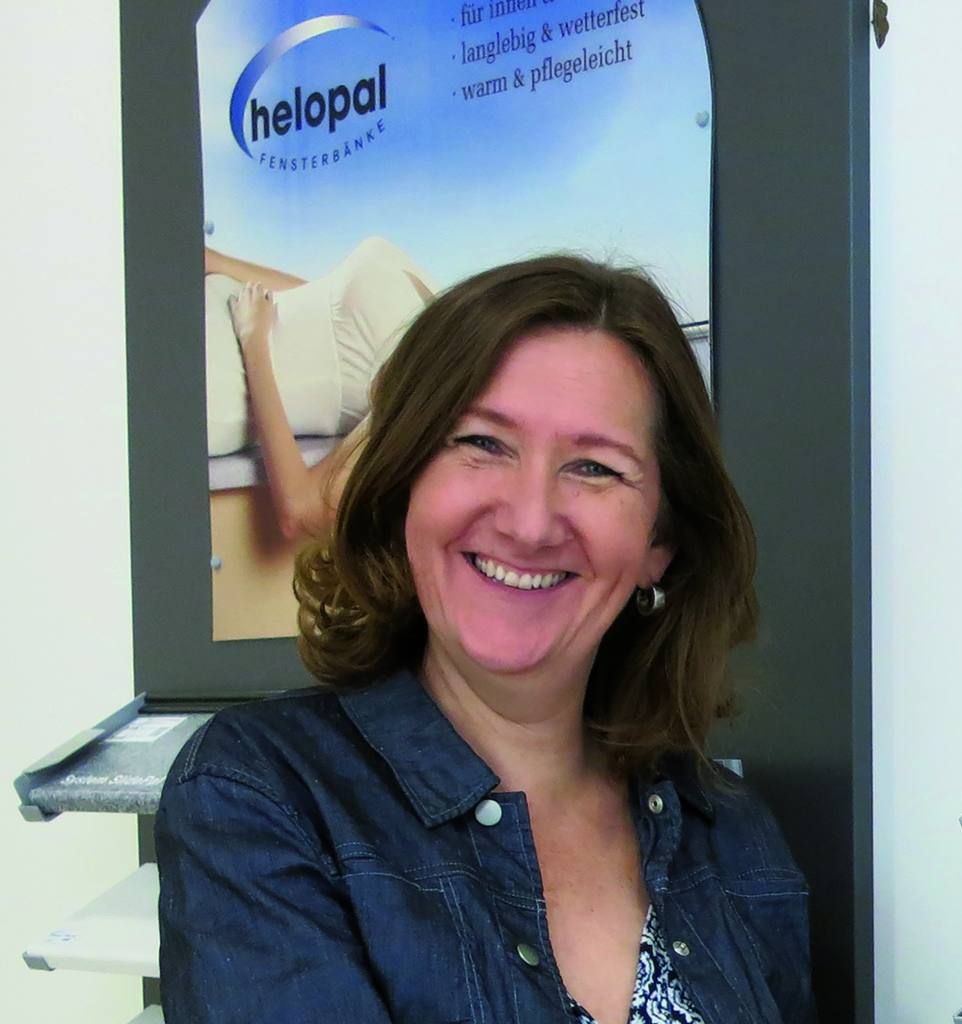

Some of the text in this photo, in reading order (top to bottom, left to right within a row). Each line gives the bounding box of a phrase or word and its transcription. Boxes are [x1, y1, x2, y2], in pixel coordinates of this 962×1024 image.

[461, 3, 484, 27] für
[462, 0, 646, 64] langlebig & wetterfest
[461, 39, 633, 101] warm & pflegeleicht
[251, 63, 387, 142] helopal
[259, 118, 386, 171] FENSTERBÄNKE
